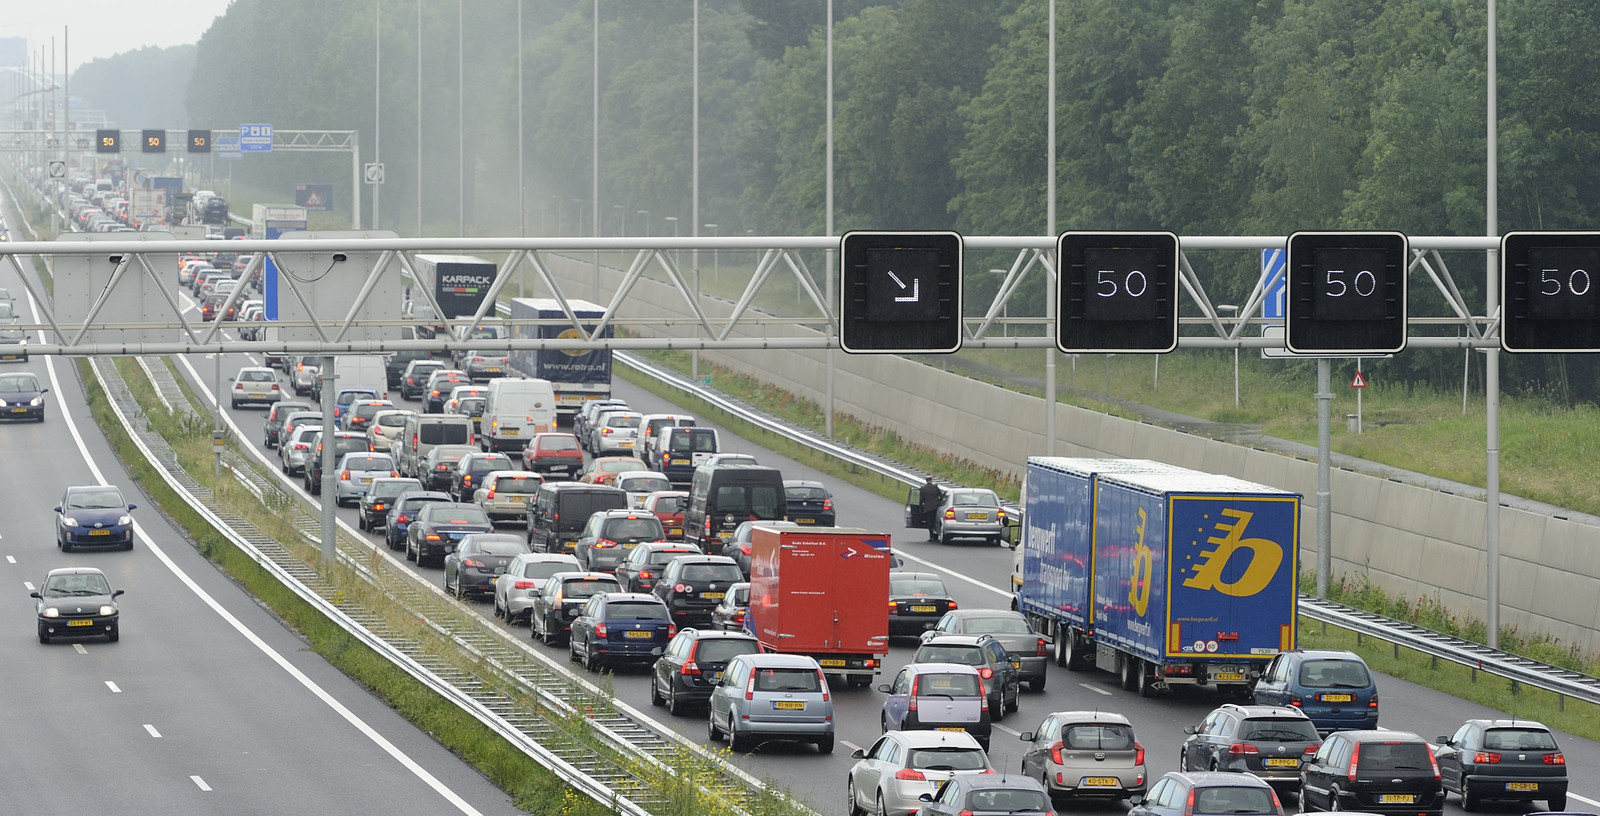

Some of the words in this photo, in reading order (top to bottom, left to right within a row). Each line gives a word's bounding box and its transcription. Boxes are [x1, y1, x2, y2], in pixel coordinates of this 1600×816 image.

[102, 137, 114, 146] 50
[148, 137, 160, 146] 50
[194, 137, 205, 146] 50
[442, 275, 490, 285] KARPACK
[1098, 271, 1146, 297] 50
[1327, 271, 1375, 296] 50
[1542, 271, 1590, 296] 50
[543, 363, 606, 371] www.rotra.nl
[1088, 777, 1115, 785] 40-STK-7
